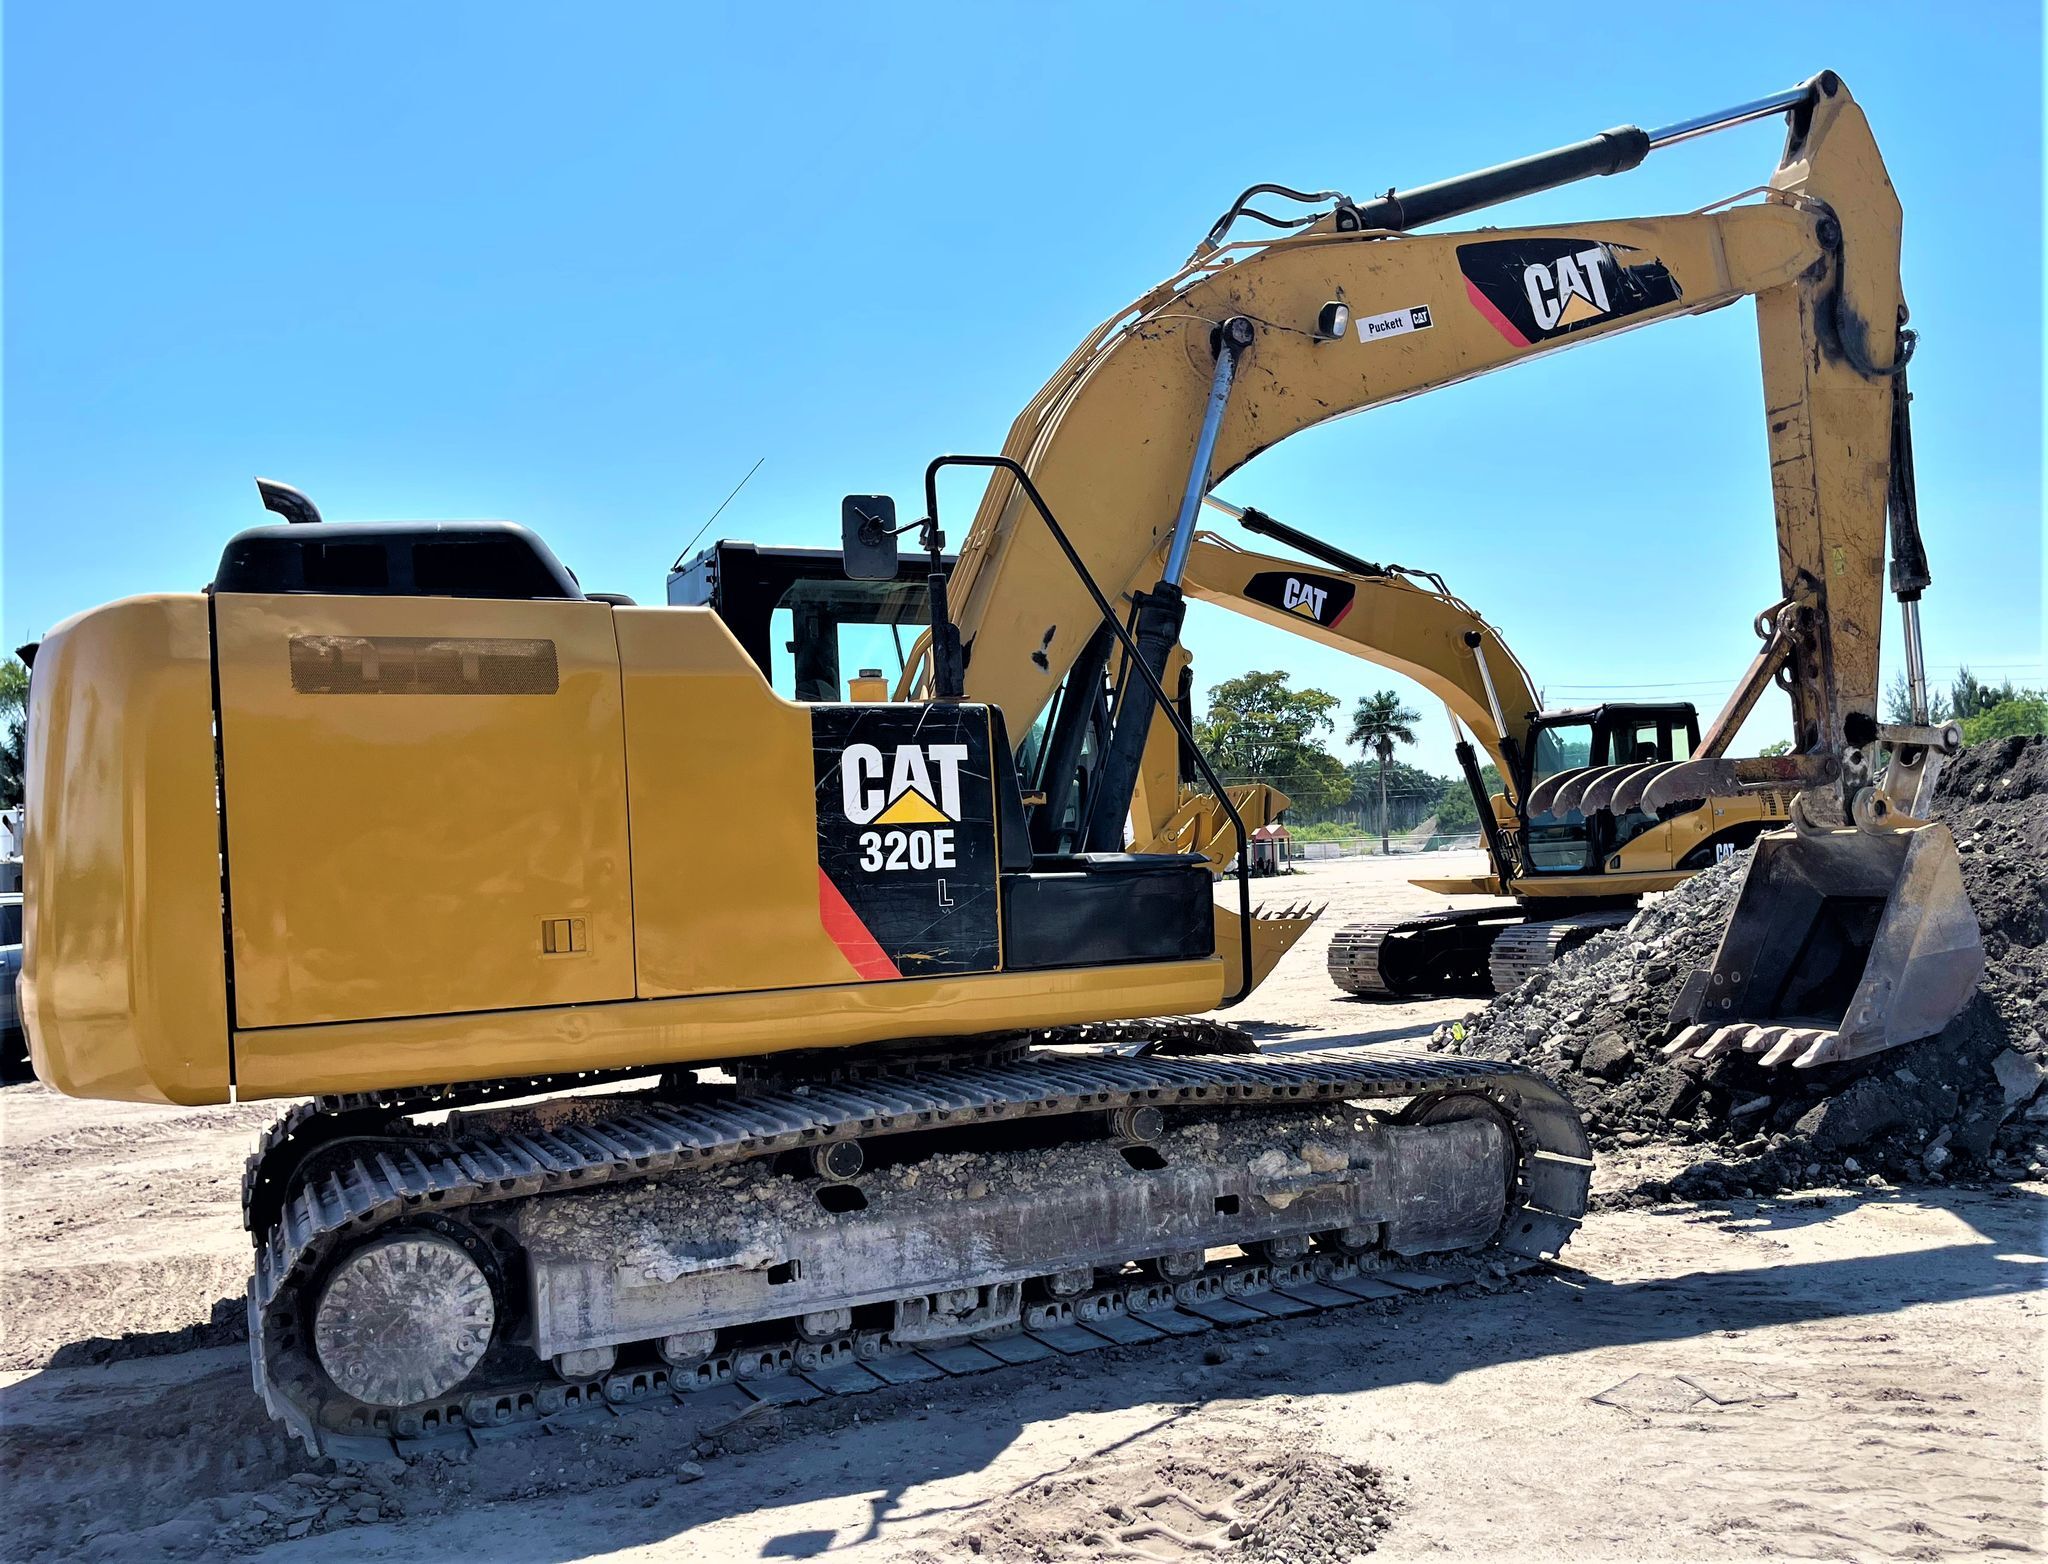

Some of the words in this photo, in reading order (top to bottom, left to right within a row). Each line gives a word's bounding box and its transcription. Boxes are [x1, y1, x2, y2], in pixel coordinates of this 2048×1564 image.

[1523, 247, 1610, 330] CAT
[1368, 317, 1403, 334] Puckett
[1412, 311, 1427, 324] CAT
[1283, 577, 1328, 621] CAT
[841, 743, 968, 825] CAT
[859, 829, 956, 872] 320E
[938, 879, 954, 906] L
